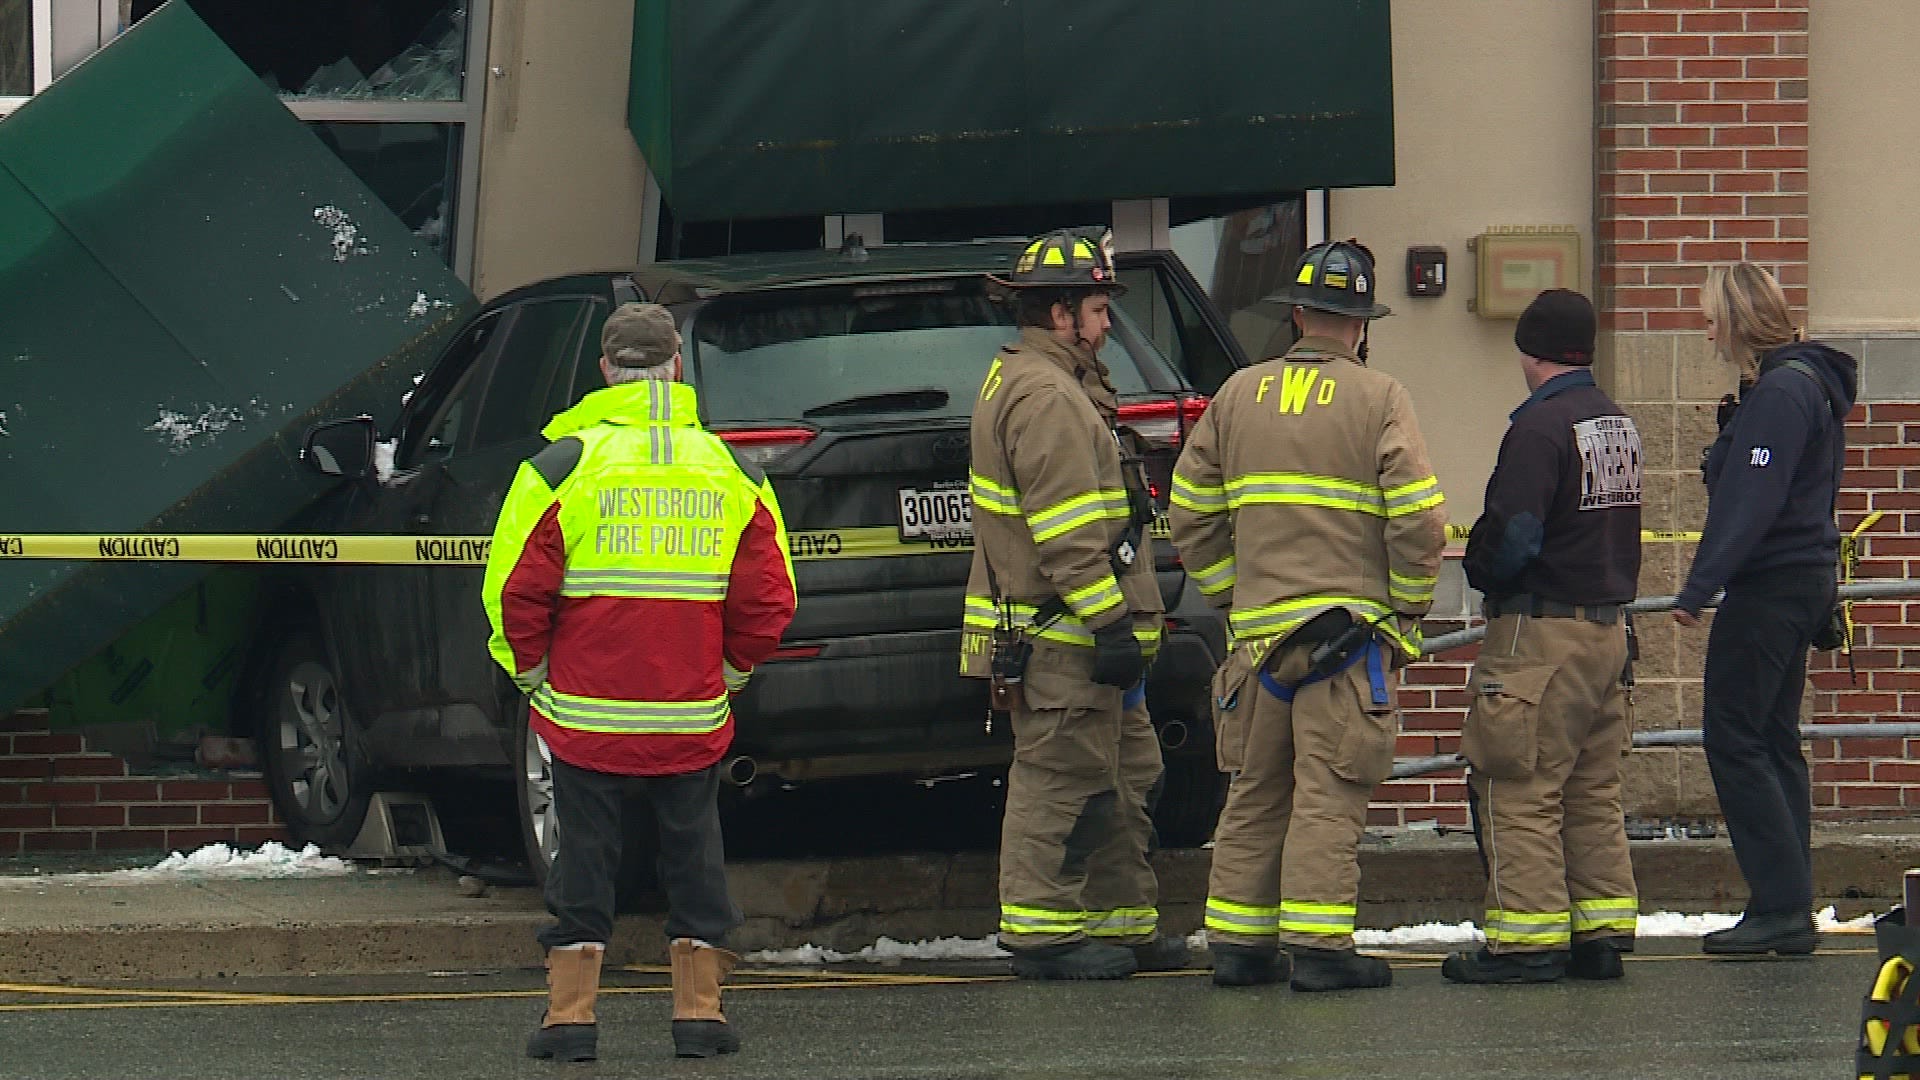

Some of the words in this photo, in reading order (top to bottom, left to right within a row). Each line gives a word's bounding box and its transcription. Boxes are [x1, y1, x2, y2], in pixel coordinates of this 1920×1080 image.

[1750, 447, 1770, 466] 110
[598, 487, 726, 520] WESTBROOK
[99, 537, 180, 557] CAUTION
[256, 538, 338, 559] CAUTION
[595, 524, 643, 555] FIRE
[650, 525, 724, 556] POLICE
[789, 533, 842, 556] CAUT
